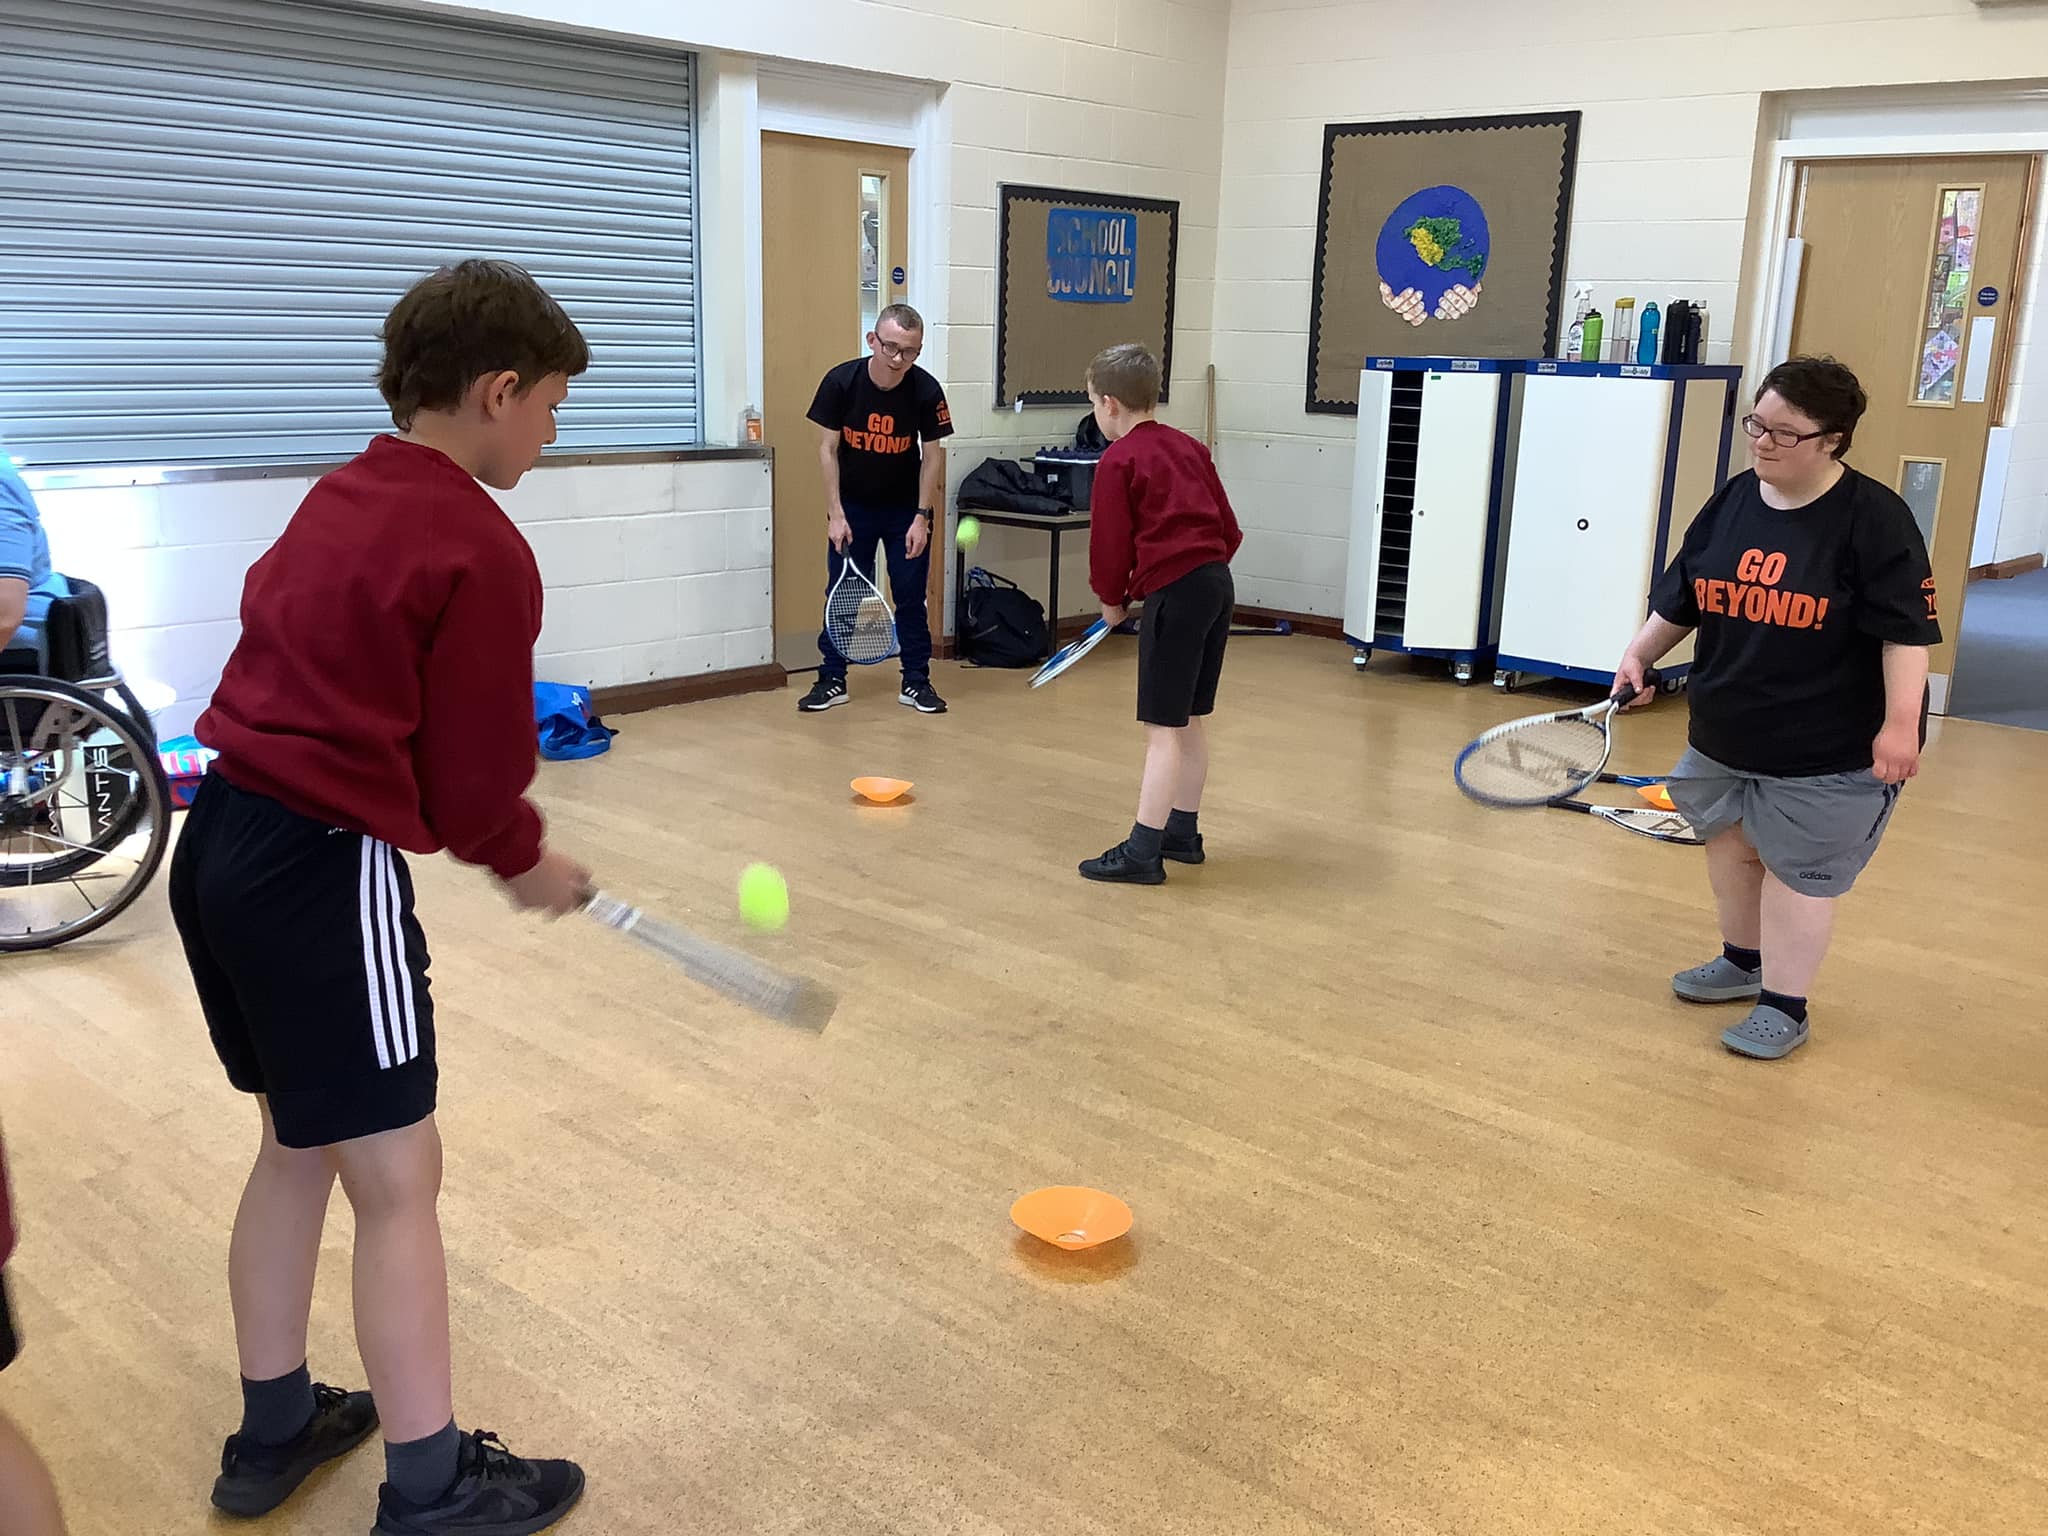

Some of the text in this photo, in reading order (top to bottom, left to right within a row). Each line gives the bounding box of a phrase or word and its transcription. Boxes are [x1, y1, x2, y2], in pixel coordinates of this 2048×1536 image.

[867, 412, 894, 435] GO
[1736, 548, 1787, 586] GO
[1694, 578, 1829, 630] BEYOND!
[1799, 871, 1832, 881] adidas
